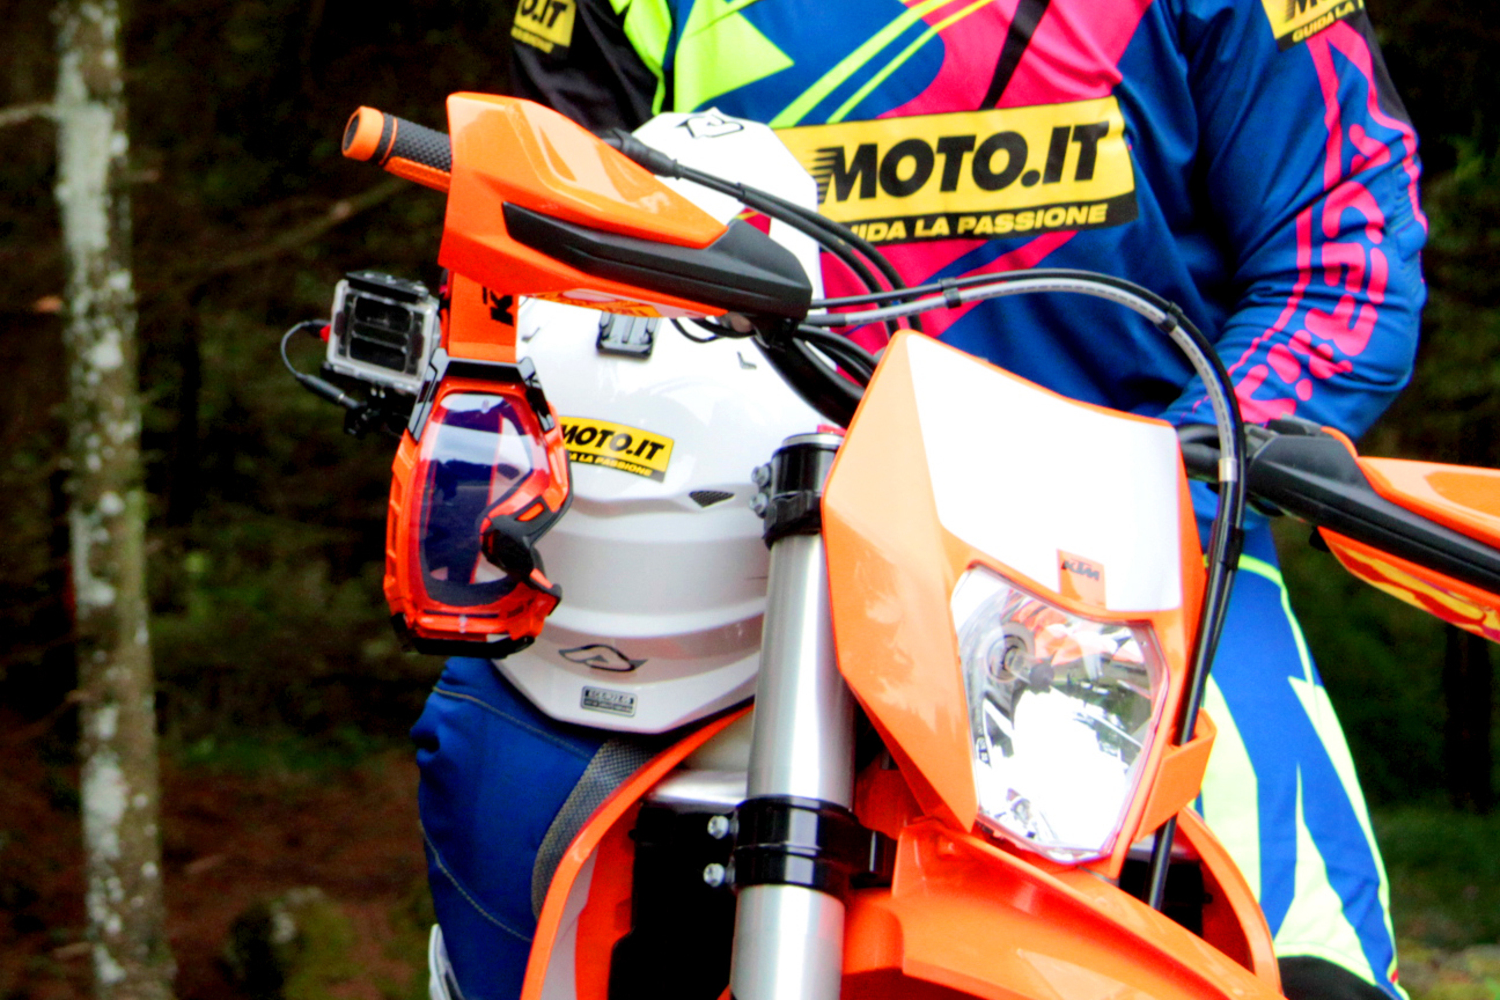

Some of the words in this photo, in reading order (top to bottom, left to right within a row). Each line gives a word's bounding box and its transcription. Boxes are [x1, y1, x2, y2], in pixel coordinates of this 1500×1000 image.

[811, 121, 1110, 205] MOTO.IT
[852, 222, 906, 243] IDA
[914, 217, 950, 237] LA
[958, 205, 1108, 235] PASSIONE
